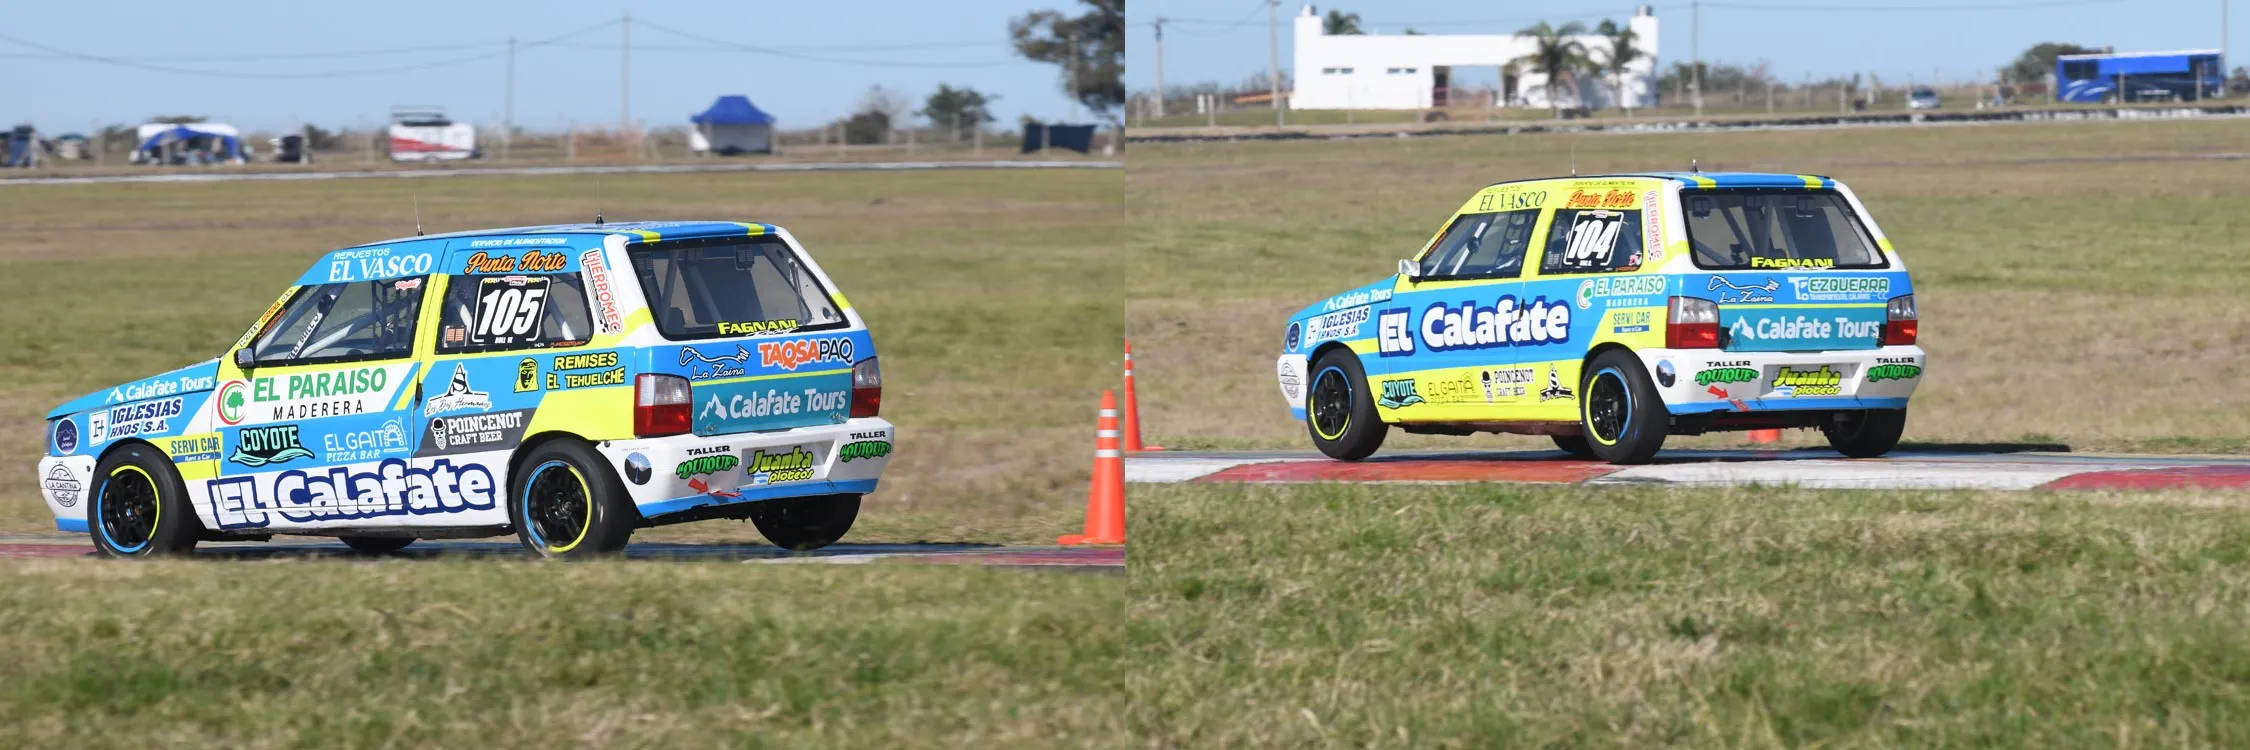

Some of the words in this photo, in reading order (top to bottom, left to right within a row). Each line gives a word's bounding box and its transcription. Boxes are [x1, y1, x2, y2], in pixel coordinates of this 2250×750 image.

[1478, 194, 1494, 211] EL
[1500, 191, 1547, 209] VASCO
[1568, 220, 1620, 259] 104
[333, 248, 390, 260] REPUESTOS
[464, 251, 516, 275] Punta
[518, 249, 567, 272] Norte
[1751, 257, 1833, 268] FAGNANI
[328, 260, 354, 282] EL
[360, 252, 432, 279] VASCO
[584, 251, 622, 332] HIERROMEC
[1370, 288, 1393, 301] Tours
[1597, 279, 1610, 295] EL
[1612, 277, 1665, 294] PARAISO
[1809, 277, 1890, 292] EZQUERRA
[477, 288, 545, 336] 105
[1322, 307, 1369, 329] IGLESIAS
[1420, 294, 1570, 352] Calafate
[717, 319, 798, 335] FAGNANI
[1756, 316, 1831, 340] Calafate
[1834, 317, 1880, 339] Tours
[554, 352, 618, 371] REMISES
[758, 337, 854, 370] TAQSAPAQ
[1706, 360, 1751, 368] TALLER
[546, 372, 560, 390] EL
[565, 366, 626, 388] TEHUELCHE
[691, 367, 710, 381] La
[711, 363, 745, 379] Zaina
[126, 380, 177, 401] Calafate
[180, 374, 213, 391] Tours
[254, 377, 281, 402] EL
[289, 367, 387, 400] PARAISO
[1382, 378, 1417, 397] COYOTE
[111, 398, 182, 425] IGLESIAS
[273, 399, 364, 421] MADERERA
[730, 390, 801, 419] Calafate
[804, 388, 847, 411] Tours
[110, 423, 140, 438] HNOS
[143, 420, 168, 433] S.A.
[447, 411, 522, 435] POINCENOT
[171, 439, 198, 454] SERVI
[200, 437, 220, 451] CAR
[240, 426, 301, 451] COYOTE
[324, 433, 344, 451] EL
[346, 422, 405, 449] GAITA
[449, 434, 478, 446] CRAFT
[479, 431, 503, 443] BEER
[850, 430, 887, 440] TALLER
[326, 451, 358, 464] PIZZA
[360, 449, 381, 461] BAR
[686, 445, 731, 456] TALLER
[767, 470, 815, 485] ploteos
[274, 457, 496, 524] Calafate
